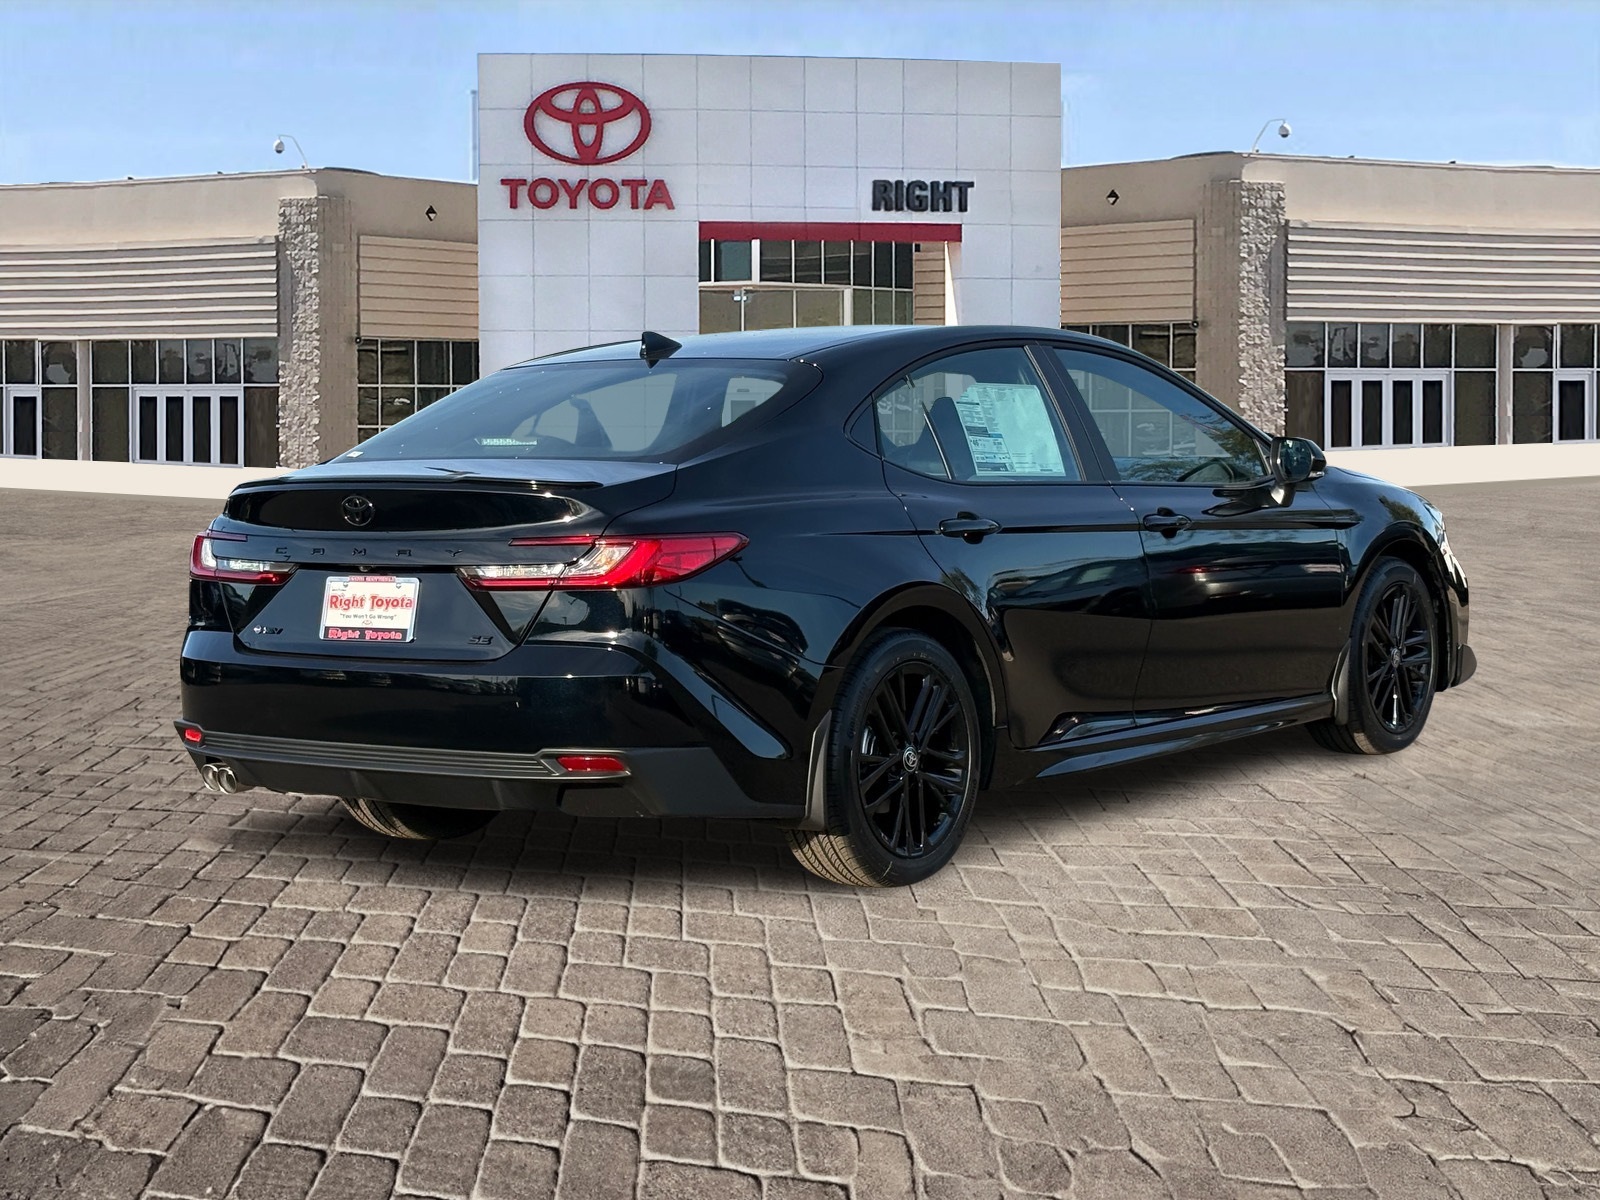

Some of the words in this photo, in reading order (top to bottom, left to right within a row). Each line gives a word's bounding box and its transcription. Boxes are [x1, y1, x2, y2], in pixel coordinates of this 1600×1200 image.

[500, 178, 675, 211] TOYOTA
[871, 179, 974, 213] RIGHT
[329, 595, 366, 610] Right
[370, 595, 413, 611] Toyota
[328, 628, 360, 640] Right
[364, 629, 402, 640] Toyota
[467, 636, 494, 645] SE
